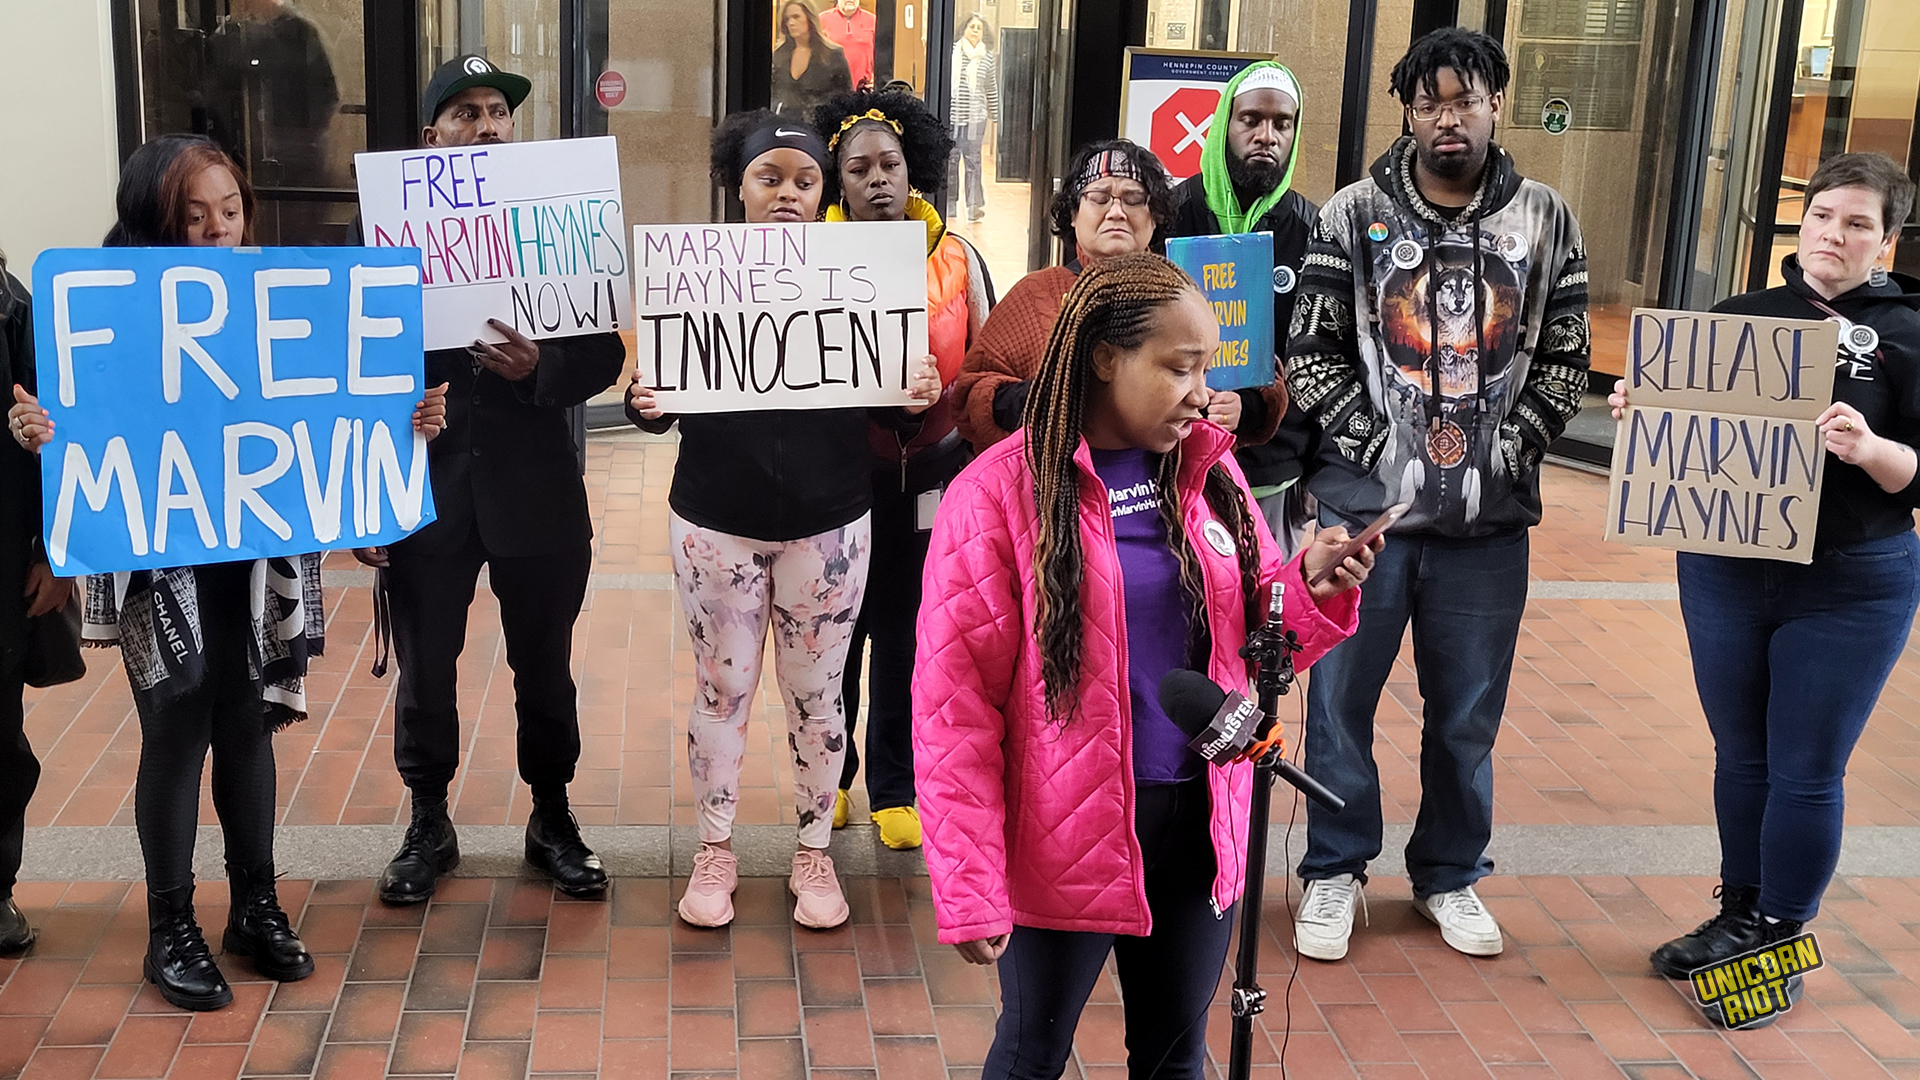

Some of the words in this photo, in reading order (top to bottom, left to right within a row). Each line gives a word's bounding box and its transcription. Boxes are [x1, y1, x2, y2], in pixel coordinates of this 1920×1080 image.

[1163, 62, 1203, 70] HENNEPIN
[1206, 63, 1239, 71] COUNTY
[402, 151, 496, 211] FREE
[511, 199, 625, 278] HAYNES
[645, 225, 807, 268] MARVIN
[645, 267, 802, 306] HAYNES
[818, 266, 877, 304] IS
[1202, 262, 1237, 291] FREE
[511, 278, 619, 335] NOW!
[1209, 299, 1247, 327] RVIN
[53, 264, 419, 408] FREE
[641, 307, 926, 394] INNOCENT
[1211, 339, 1249, 368] YNES
[1633, 314, 1820, 402] RELEASE
[1625, 409, 1820, 492] MARVIN
[49, 417, 427, 567] MARVIN
[1618, 480, 1803, 550] HAYNES
[153, 591, 190, 665] CHANEL
[1200, 734, 1231, 760] LISTEN
[1220, 699, 1255, 739] LISTEN
